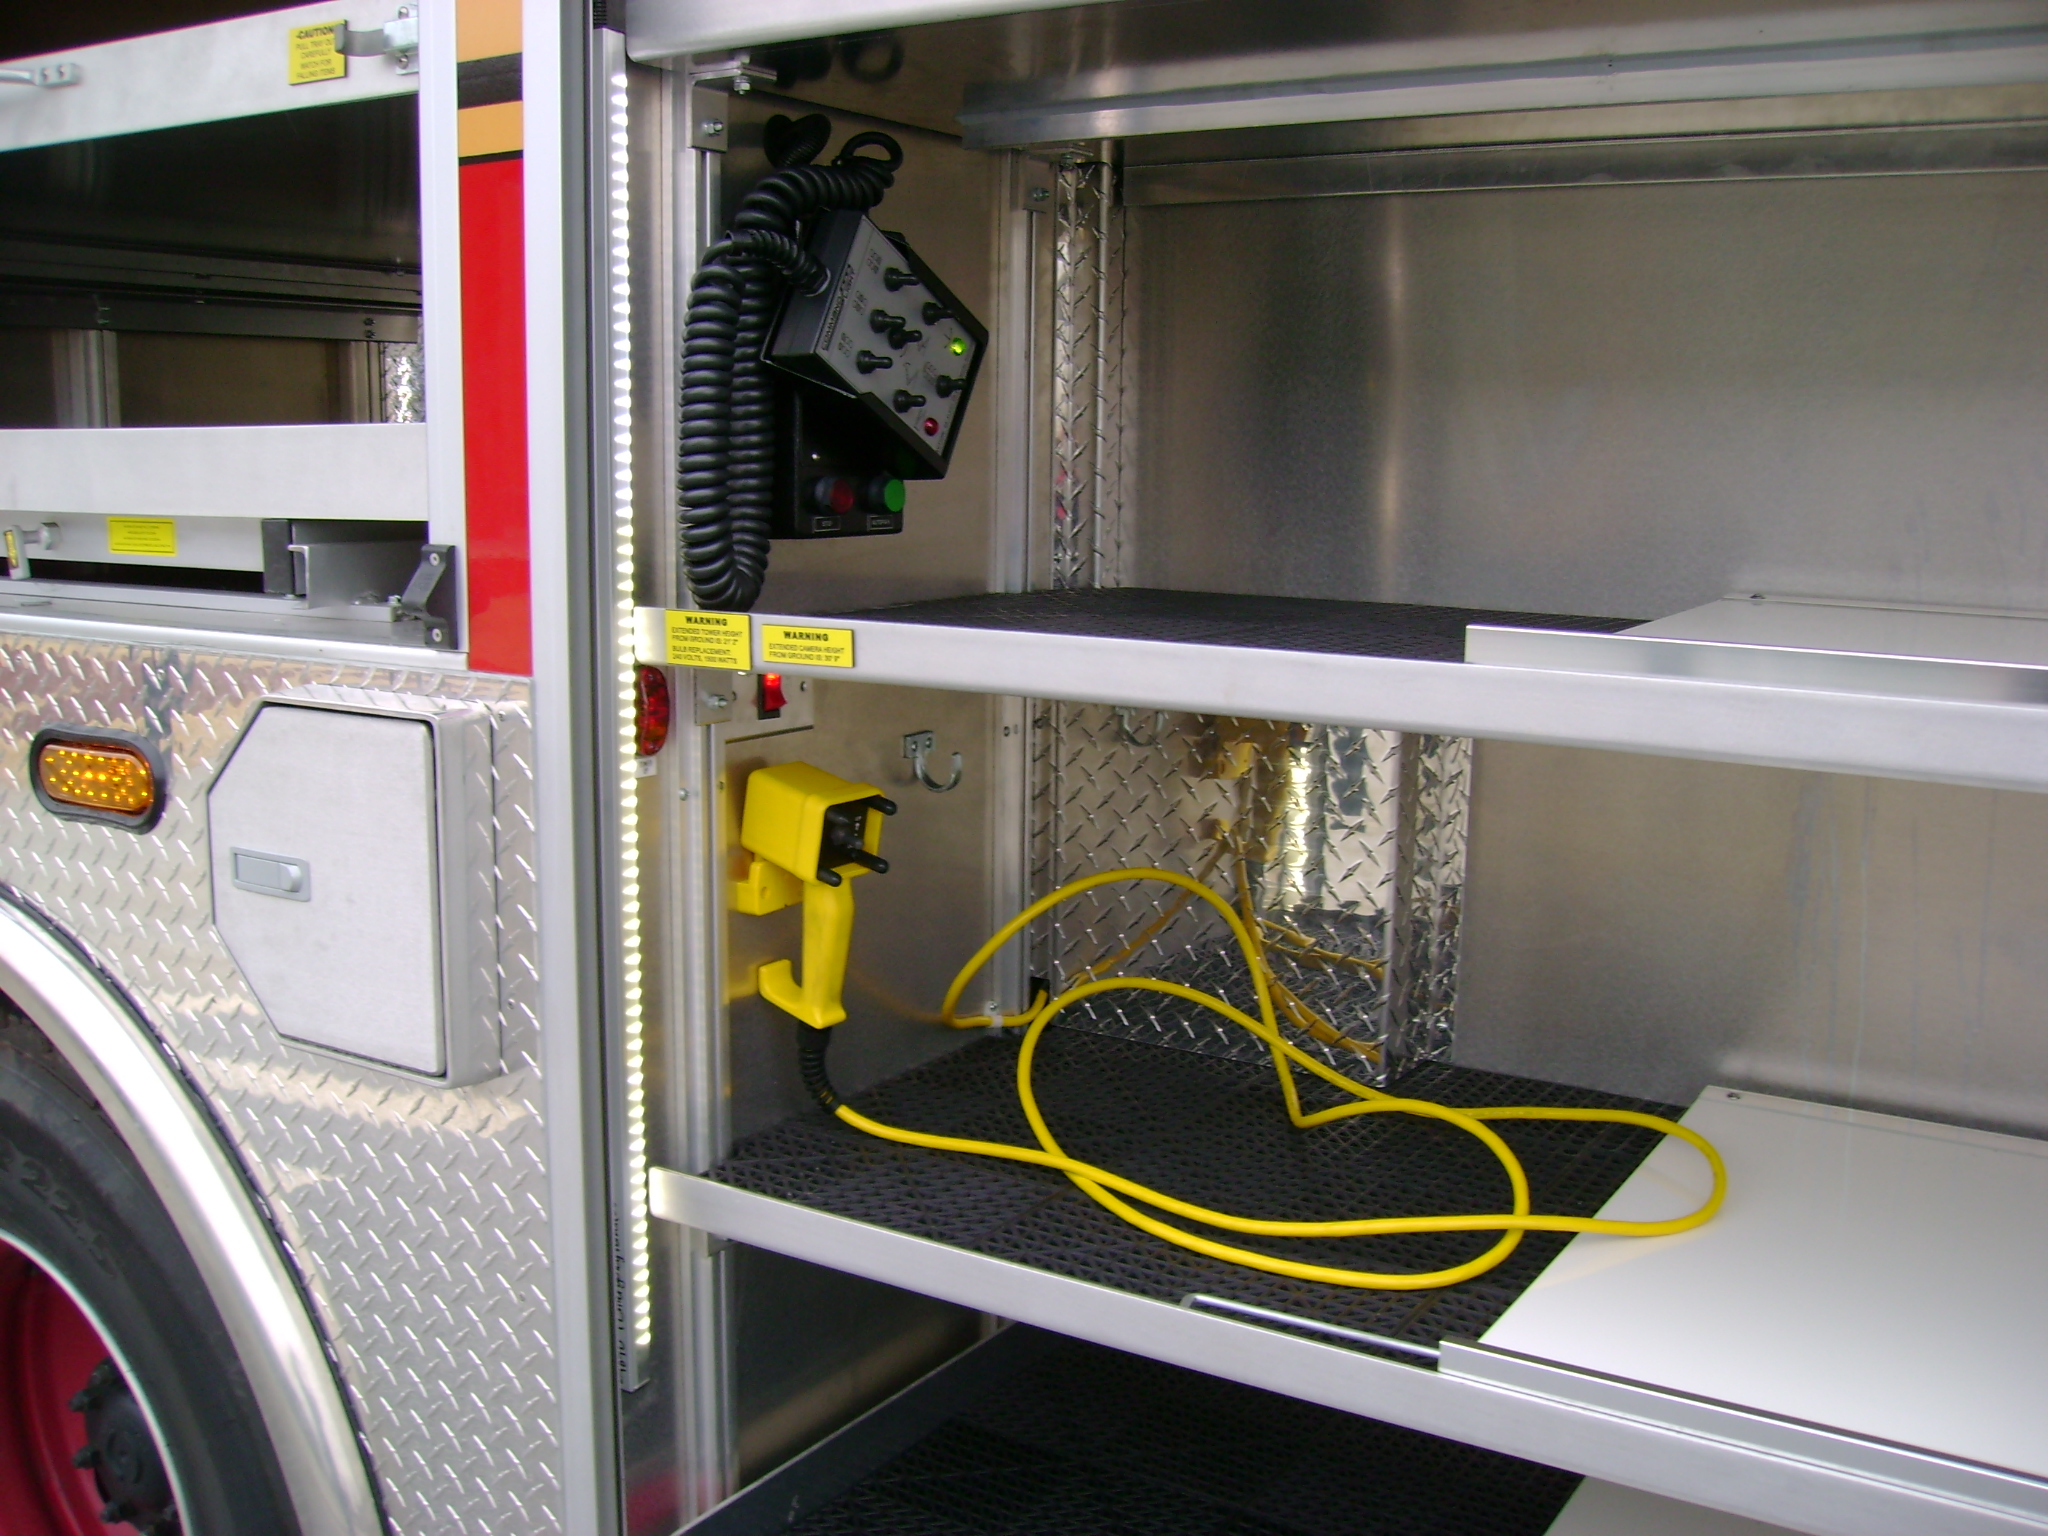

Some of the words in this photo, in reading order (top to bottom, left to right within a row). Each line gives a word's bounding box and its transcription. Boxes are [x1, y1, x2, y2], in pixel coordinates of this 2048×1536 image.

[685, 616, 728, 627] WARNING
[671, 627, 700, 635] EXTENDED
[701, 628, 721, 636] TOWER
[783, 631, 829, 642] WARNING
[672, 634, 688, 642] FROM
[689, 635, 714, 644] GROUND
[768, 643, 798, 651] EXTENDED
[799, 645, 822, 653] CAMERA
[823, 646, 845, 654] HEIGHT
[788, 652, 814, 660] GROUND
